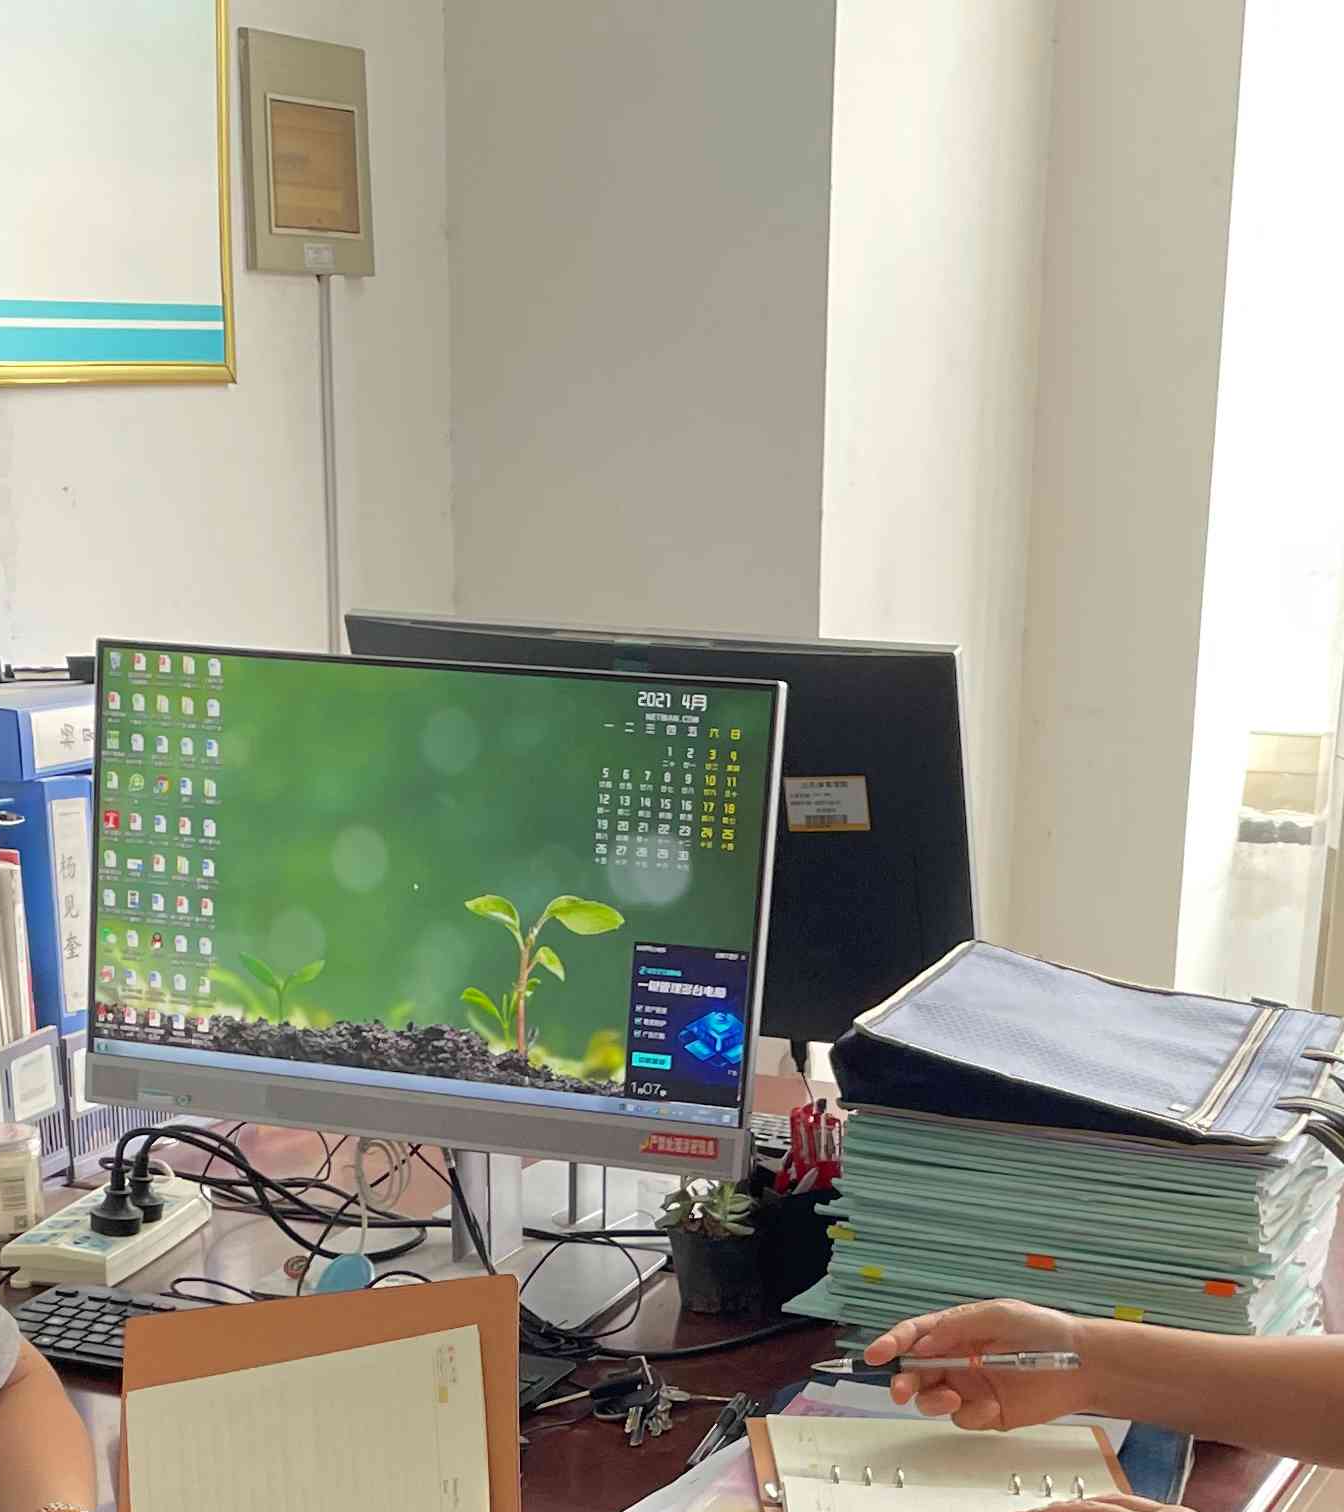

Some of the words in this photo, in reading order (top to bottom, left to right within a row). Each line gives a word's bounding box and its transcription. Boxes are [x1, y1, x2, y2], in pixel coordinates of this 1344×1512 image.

[637, 691, 672, 708] 2021
[681, 694, 708, 712] 4月
[624, 722, 635, 733] 二
[705, 775, 717, 786] 10
[726, 776, 737, 788] 11
[598, 794, 610, 805] 12
[619, 795, 631, 806] 13
[640, 797, 652, 808] 14
[660, 798, 671, 810] 15
[681, 800, 693, 811] 16
[703, 802, 714, 813] 17
[638, 822, 649, 833] 21
[658, 823, 670, 835] 22
[679, 825, 691, 837] 23
[616, 845, 628, 856] 27
